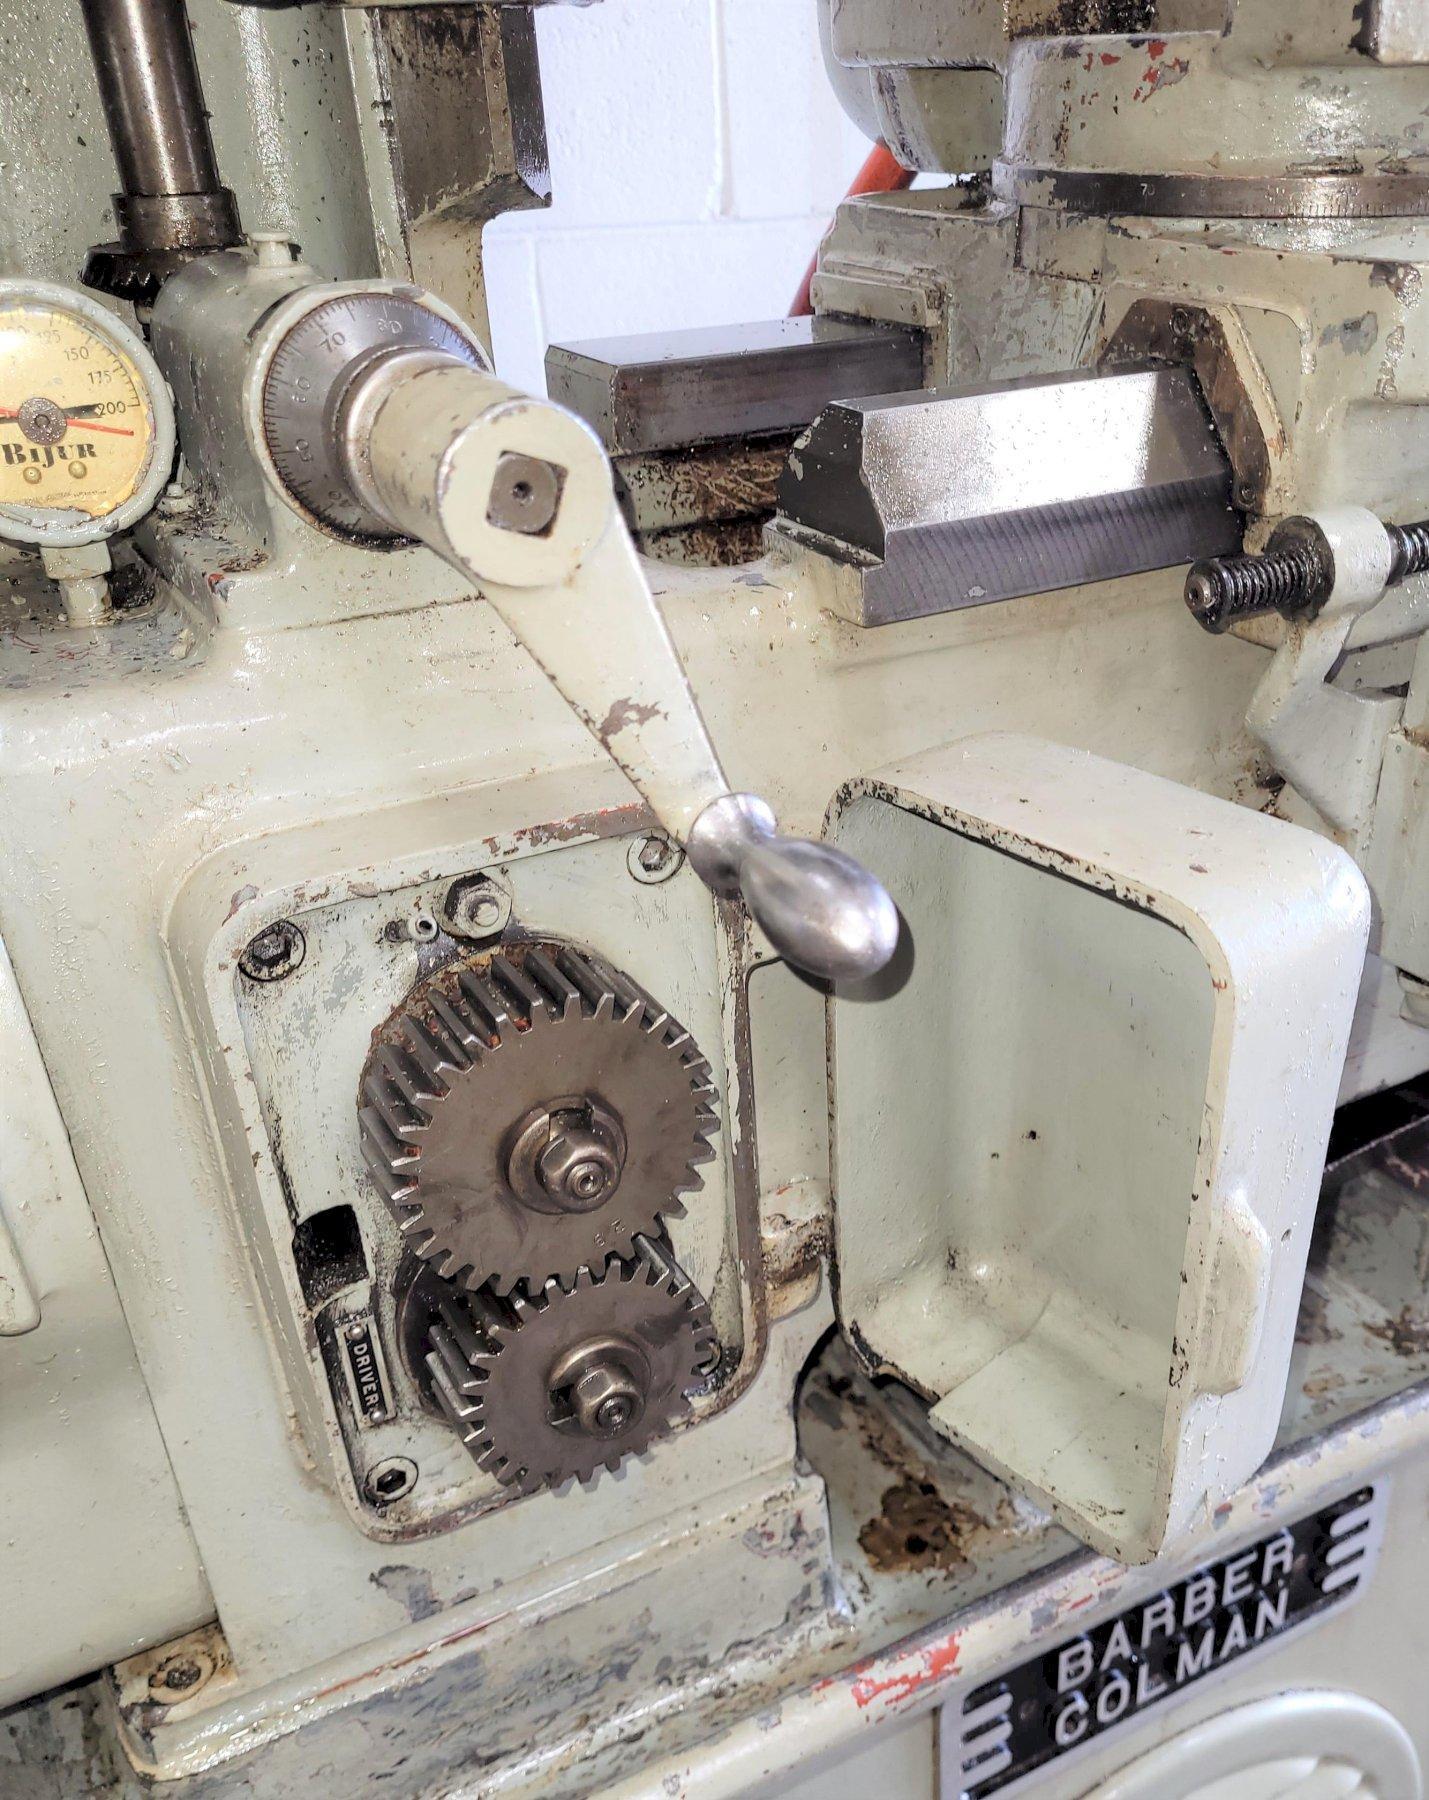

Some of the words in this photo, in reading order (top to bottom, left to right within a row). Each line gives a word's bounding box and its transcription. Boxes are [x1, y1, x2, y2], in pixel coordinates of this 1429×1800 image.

[320, 331, 346, 352] 70
[64, 346, 89, 361] 150
[88, 370, 112, 384] 175
[97, 401, 126, 416] 200
[353, 1342, 380, 1407] DRIVER
[1058, 1534, 1295, 1694] BARBER
[1055, 1589, 1289, 1747] COLMAN
